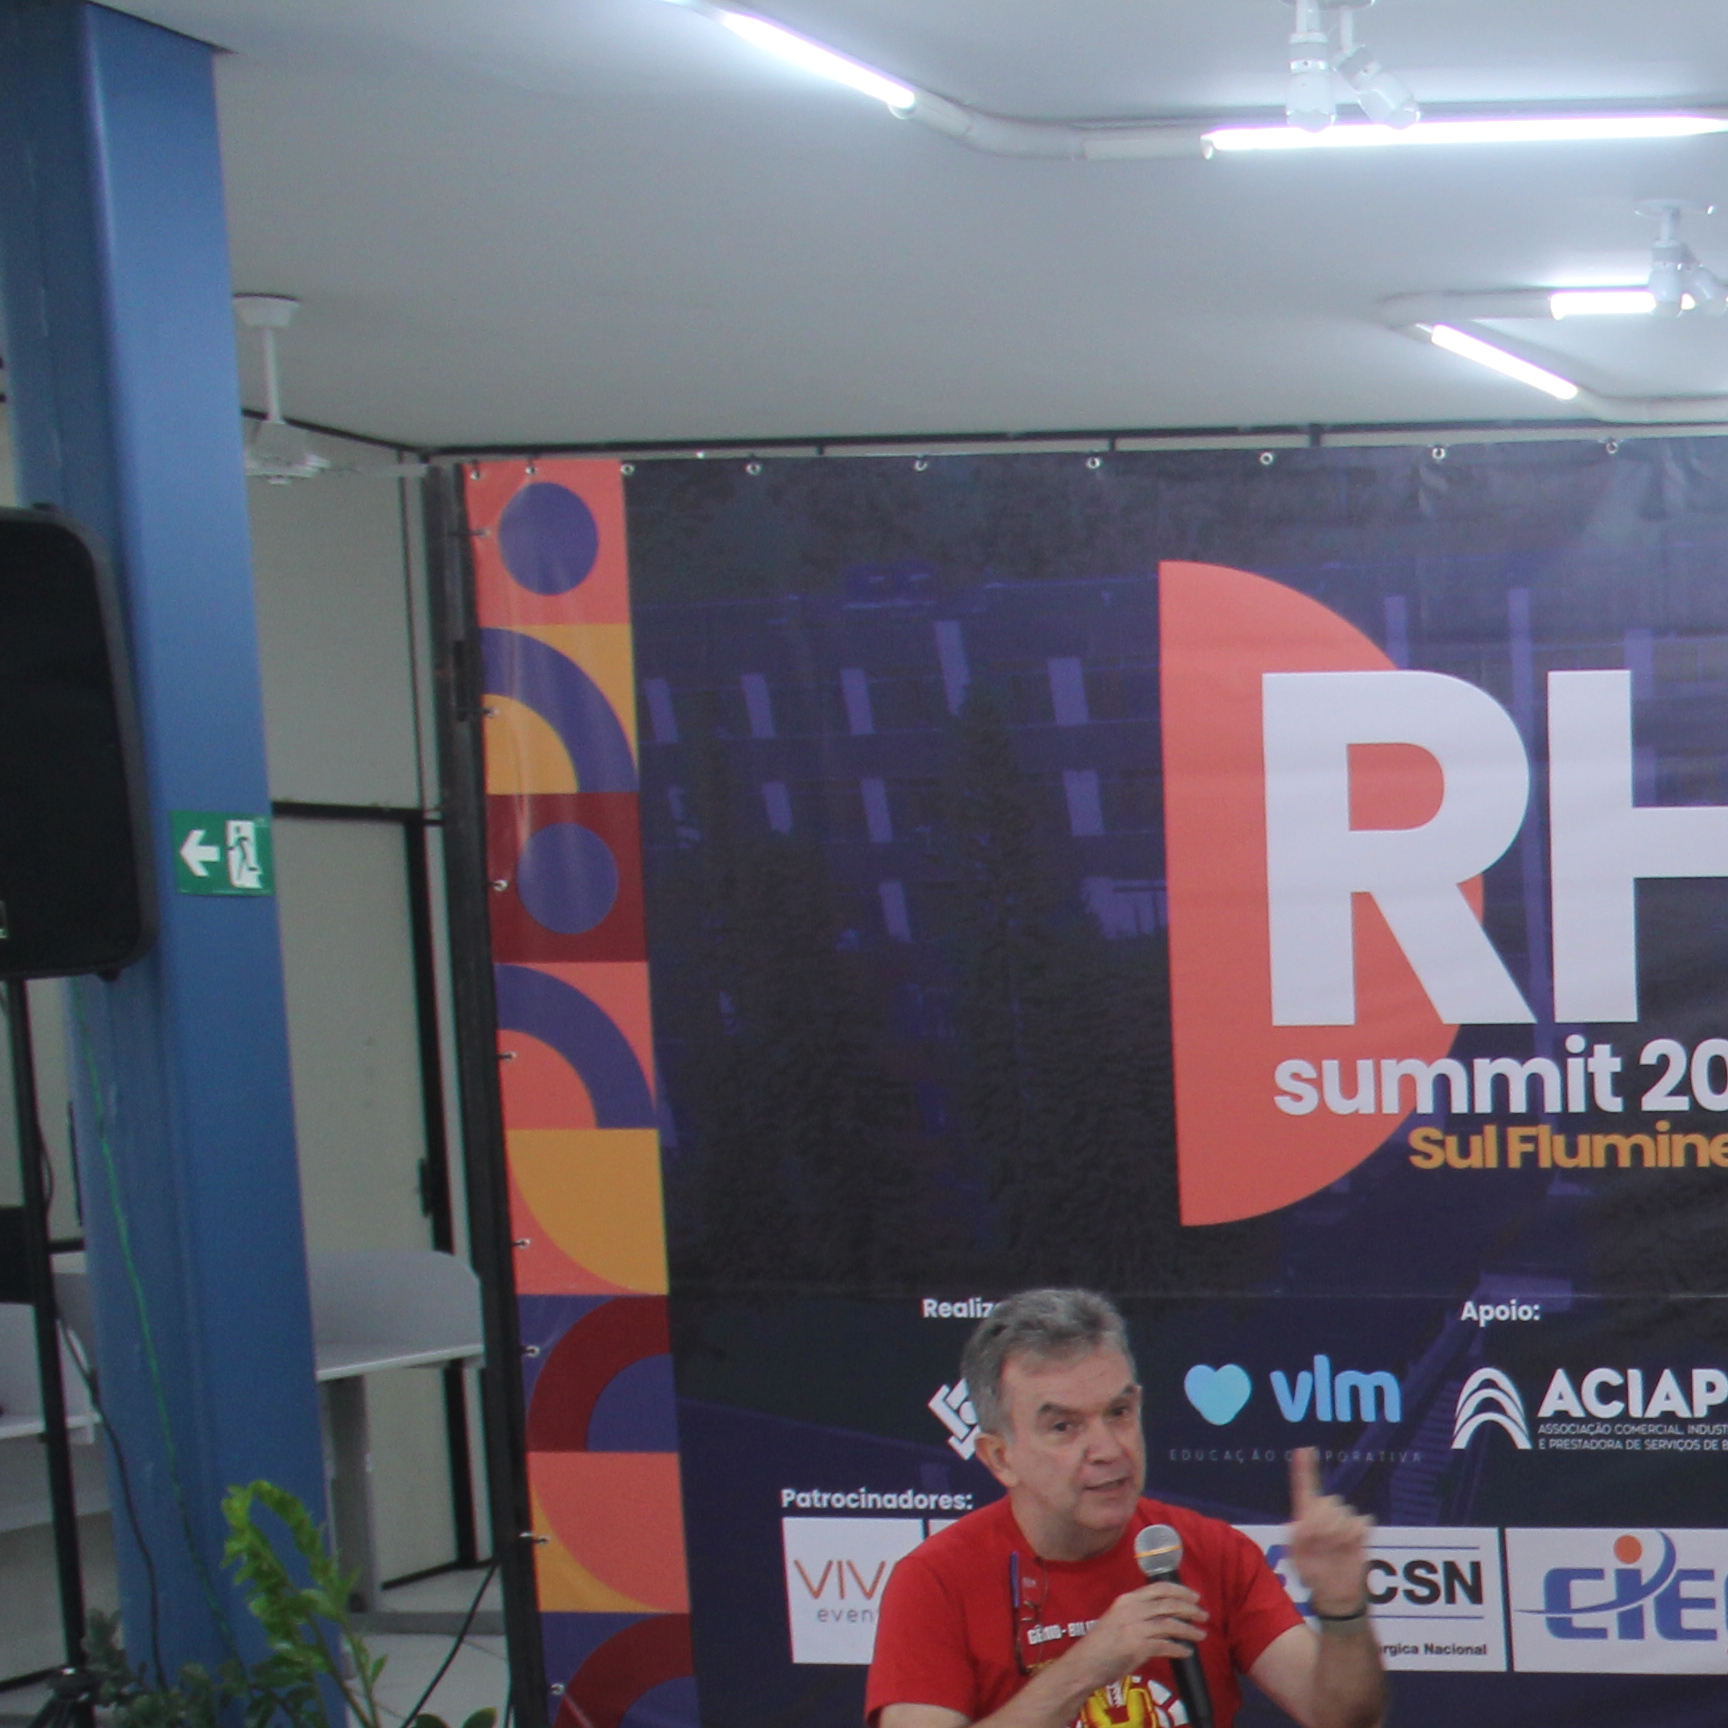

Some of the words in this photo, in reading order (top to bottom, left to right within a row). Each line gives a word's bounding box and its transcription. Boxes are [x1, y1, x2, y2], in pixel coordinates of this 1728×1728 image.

[1273, 1035, 1622, 1115] summit
[1409, 1126, 1498, 1170] Sul
[923, 1298, 1002, 1318] Realiz
[1461, 1299, 1540, 1327] Apoio:
[1270, 1354, 1401, 1423] vlm
[1538, 1420, 1611, 1437] ASSOCIAÇÃO
[1284, 1449, 1423, 1463] CPORATIVA
[1538, 1439, 1546, 1450] E
[1549, 1439, 1623, 1450] PRESTADORA
[1626, 1439, 1641, 1450] DE
[1644, 1439, 1701, 1453] SERVIÇOS
[1704, 1439, 1719, 1450] DE
[780, 1486, 974, 1511] Patrocinadores:
[1366, 1560, 1484, 1605] CSN
[817, 1607, 879, 1623] even
[1379, 1643, 1418, 1656] rgica
[1424, 1643, 1487, 1655] Nacional
